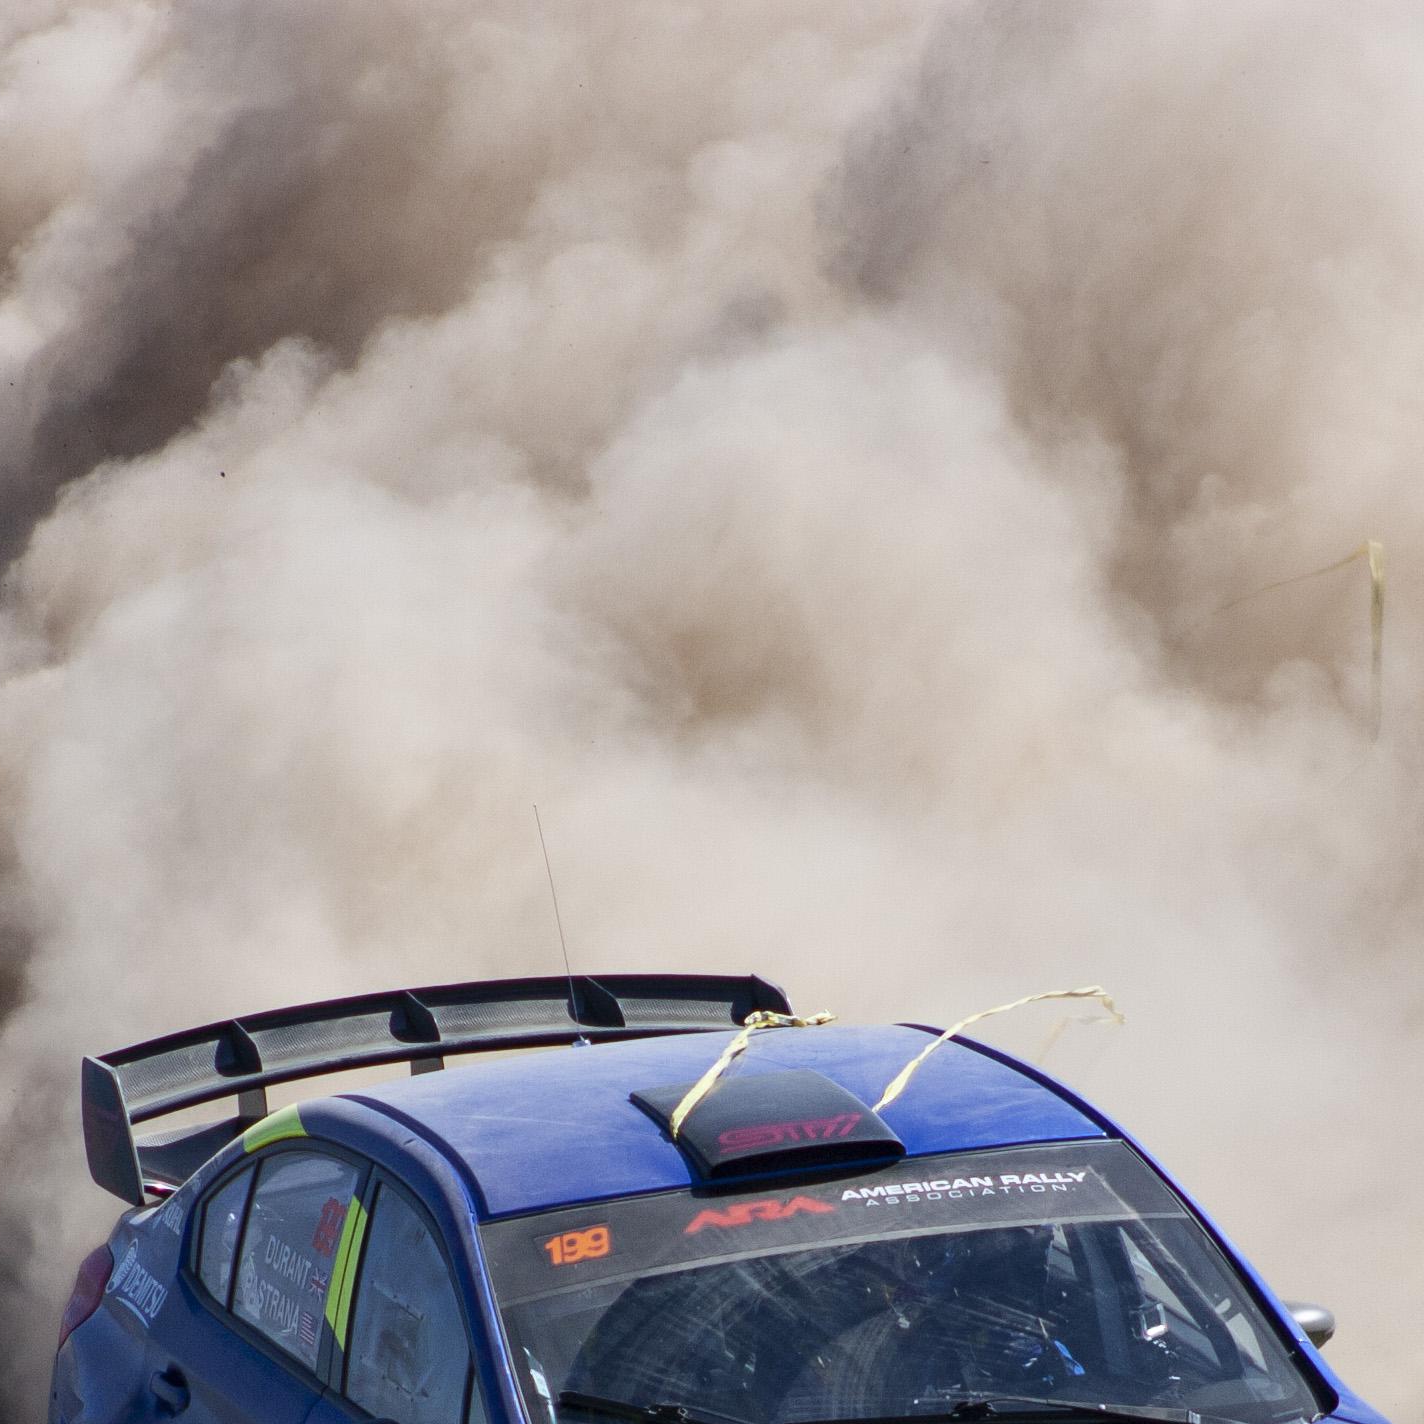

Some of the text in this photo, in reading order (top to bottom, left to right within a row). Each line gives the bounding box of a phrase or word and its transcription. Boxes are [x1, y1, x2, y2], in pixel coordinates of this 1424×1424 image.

[841, 1172, 1087, 1201] AMERICAN RALLY
[866, 1183, 1068, 1207] ASSOCIATION
[682, 1195, 836, 1235] ARA
[265, 1234, 312, 1290] DURANT
[544, 1226, 610, 1266] 199
[122, 1261, 168, 1319] IDEMITSU
[243, 1271, 301, 1336] PASTRANA
